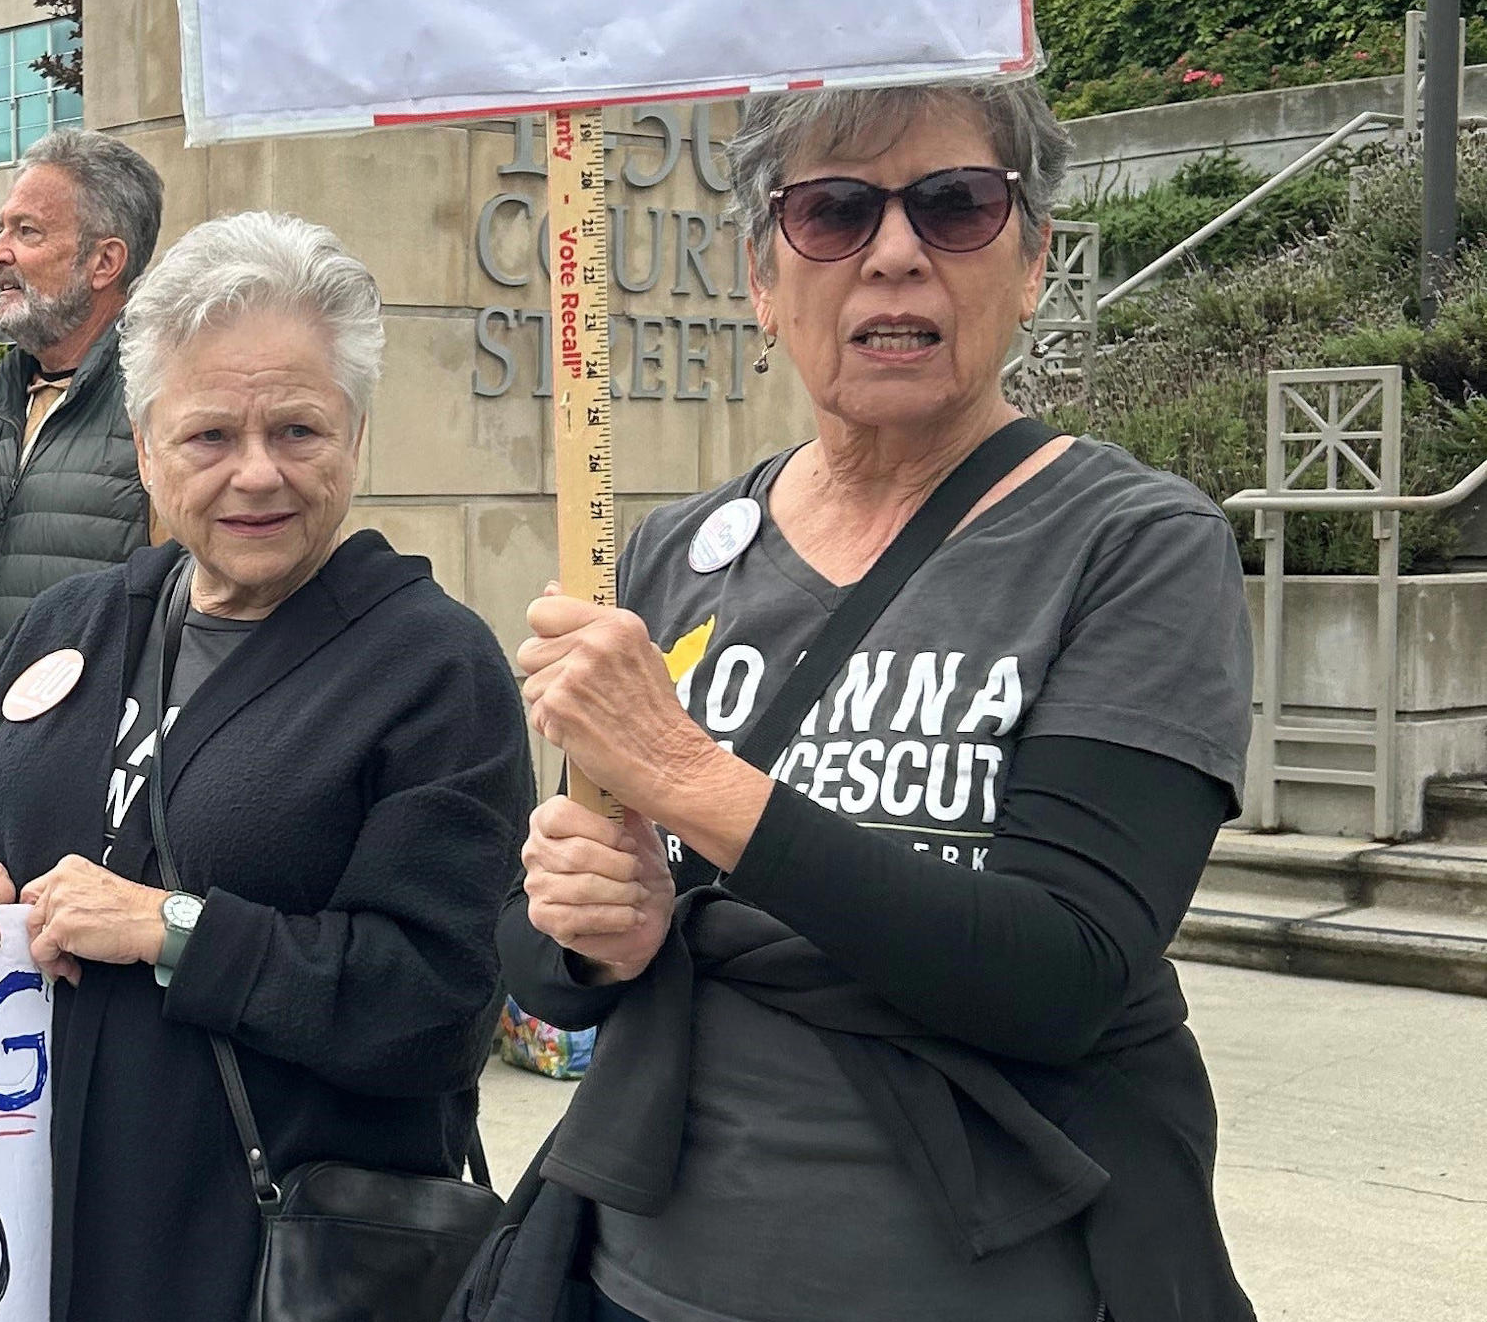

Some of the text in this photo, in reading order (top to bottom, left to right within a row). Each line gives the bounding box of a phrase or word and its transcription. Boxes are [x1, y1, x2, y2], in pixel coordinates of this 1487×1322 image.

[477, 192, 749, 299] CURT
[472, 306, 759, 402] STEET
[676, 644, 1023, 736] ONNA
